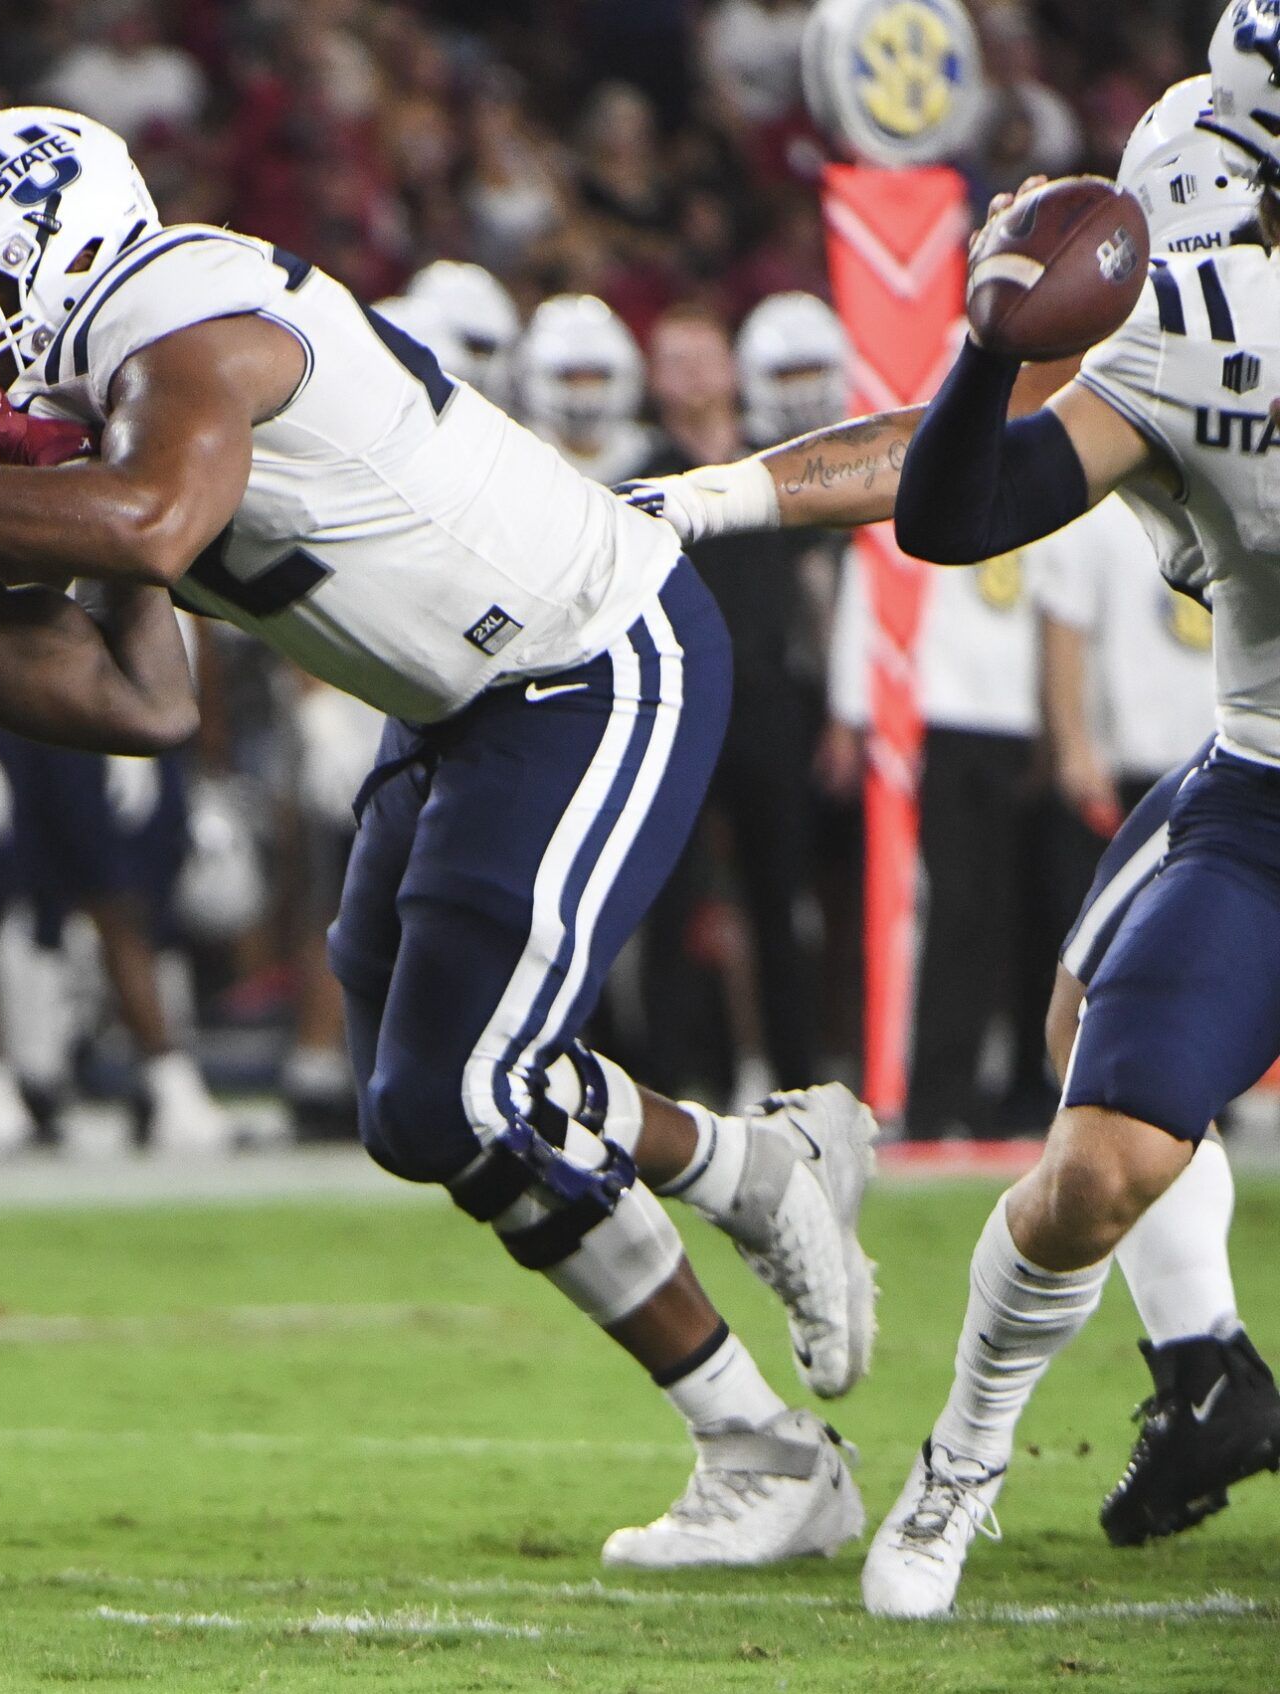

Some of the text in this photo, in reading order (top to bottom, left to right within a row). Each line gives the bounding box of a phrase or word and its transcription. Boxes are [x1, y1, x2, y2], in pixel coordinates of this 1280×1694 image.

[1168, 231, 1222, 253] UTAH
[785, 453, 881, 494] Money
[473, 615, 504, 642] 2XL
